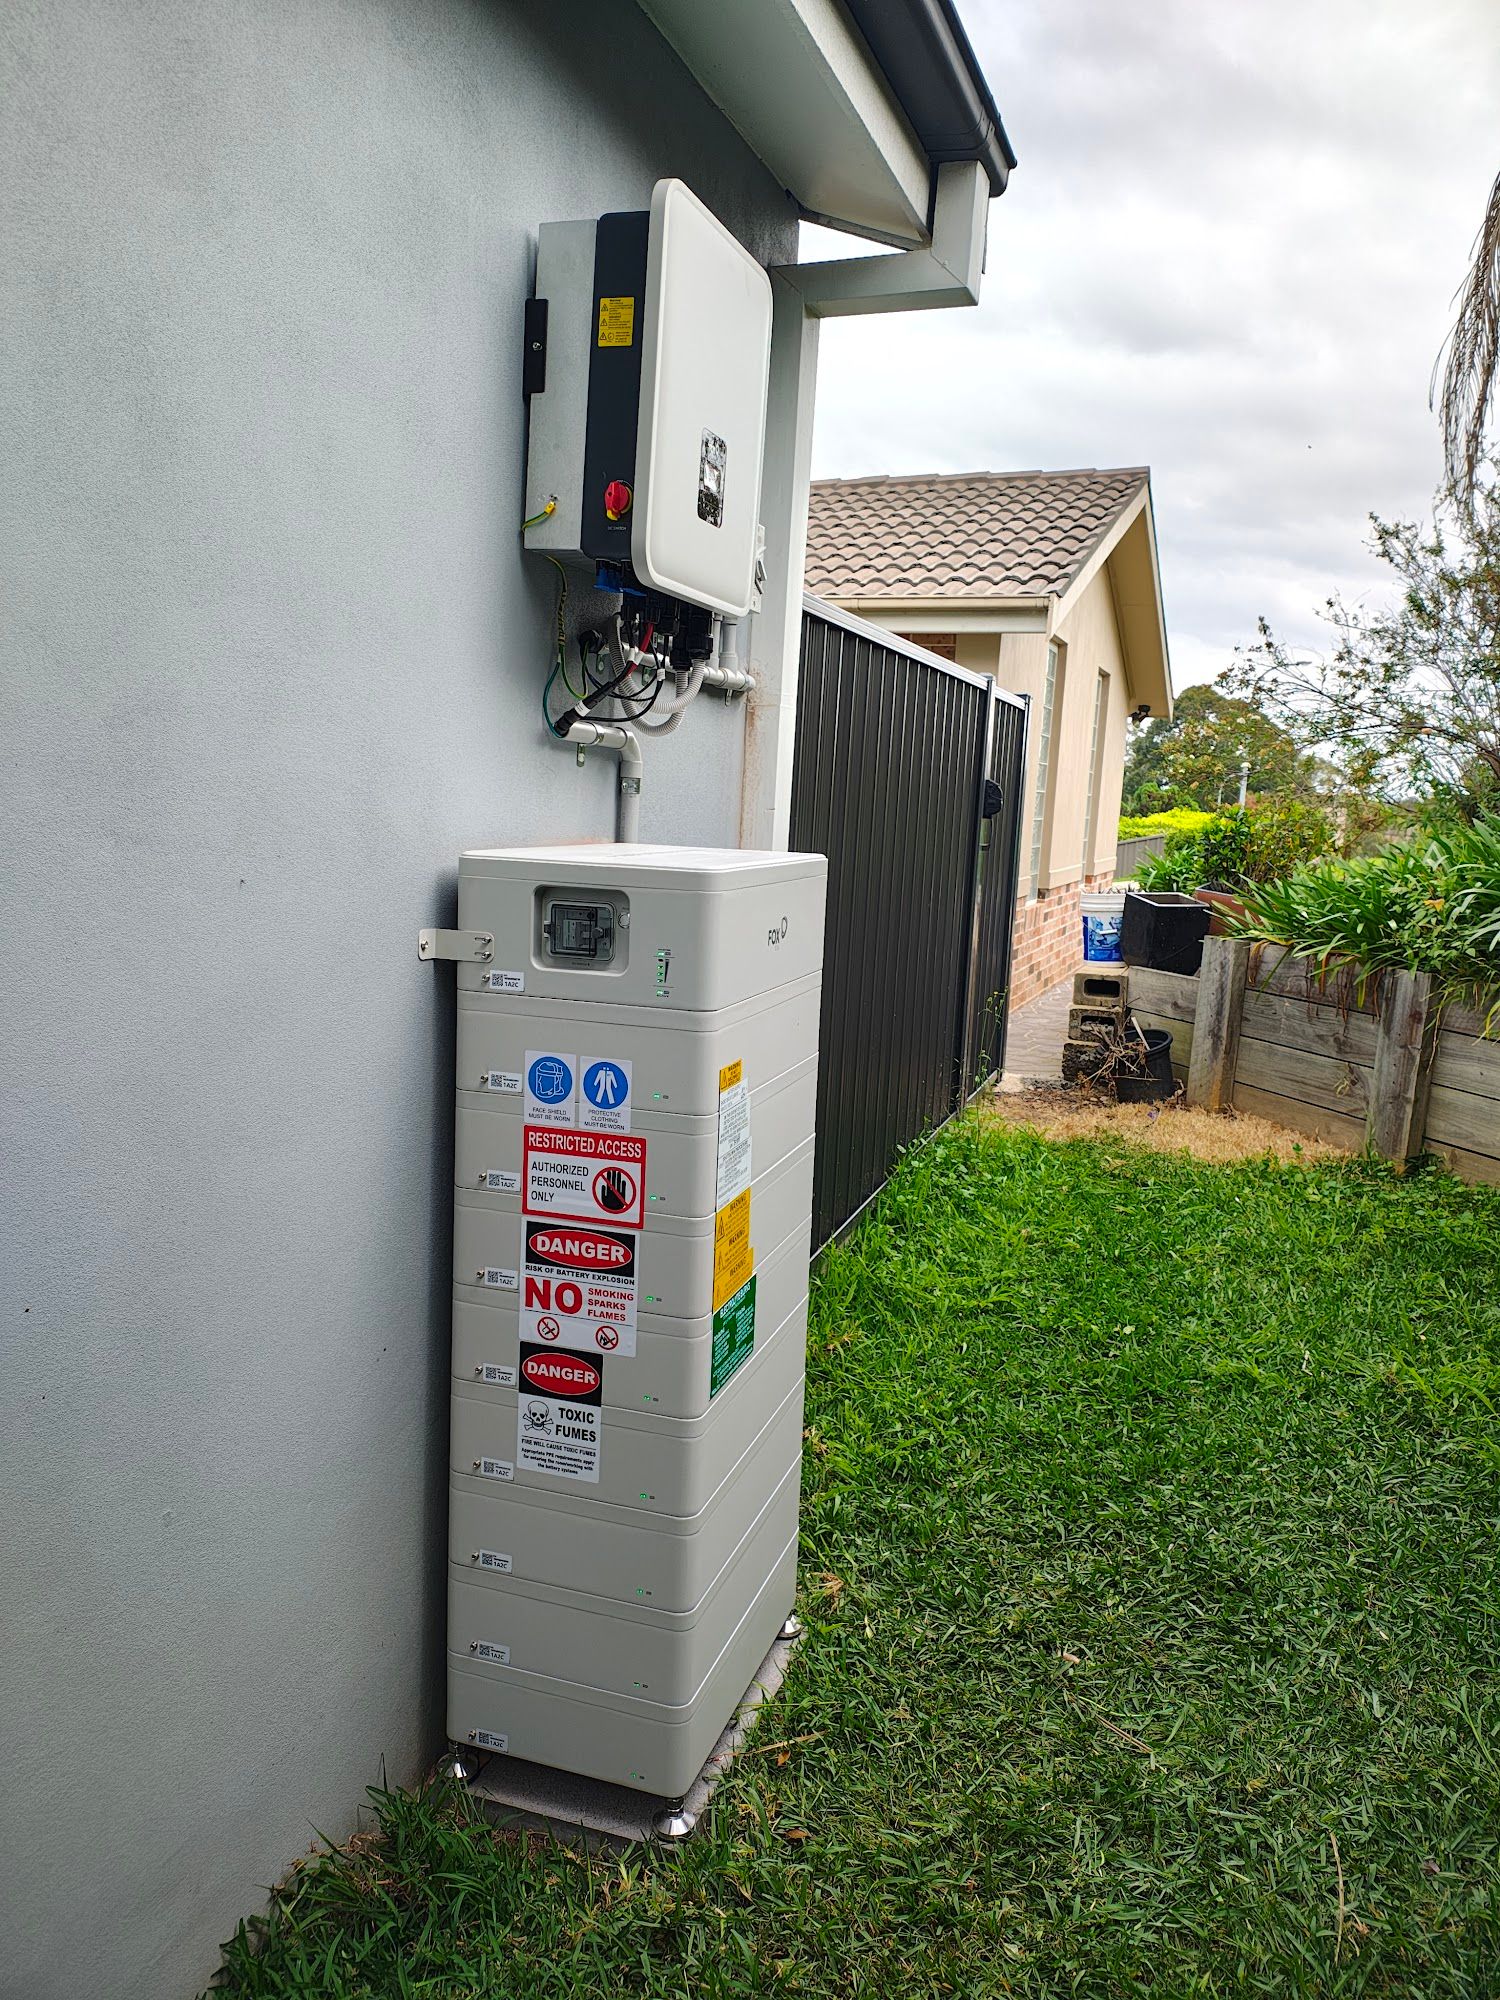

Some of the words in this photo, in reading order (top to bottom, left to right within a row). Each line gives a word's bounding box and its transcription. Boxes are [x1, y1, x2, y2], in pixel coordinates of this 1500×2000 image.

[768, 928, 780, 946] FOX
[588, 1109, 621, 1118] PROTECTIVE
[528, 1131, 595, 1153] RESTRICTED
[597, 1139, 642, 1158] ACCESS
[532, 1161, 588, 1176] AUTHORIZED
[531, 1176, 586, 1192] PERSONNEL
[531, 1191, 555, 1202] ONLY
[730, 1192, 746, 1212] WARNING
[729, 1226, 745, 1246] WARNING
[536, 1235, 625, 1263] DANGER
[730, 1256, 746, 1276] WARNING
[557, 1269, 590, 1279] BATTERY
[592, 1274, 635, 1285] EXPLOSION
[525, 1277, 582, 1314] NO
[588, 1288, 634, 1301] SMOKING
[588, 1299, 626, 1310] SPARKS
[588, 1309, 626, 1321] FLAMES
[527, 1361, 595, 1384] DANGER
[558, 1407, 594, 1424] TOXIC
[555, 1424, 596, 1442] FUMES
[522, 1447, 545, 1456] Appropriate
[555, 1454, 582, 1463] requirements
[530, 1455, 546, 1464] entering
[579, 1449, 596, 1457] FUMES
